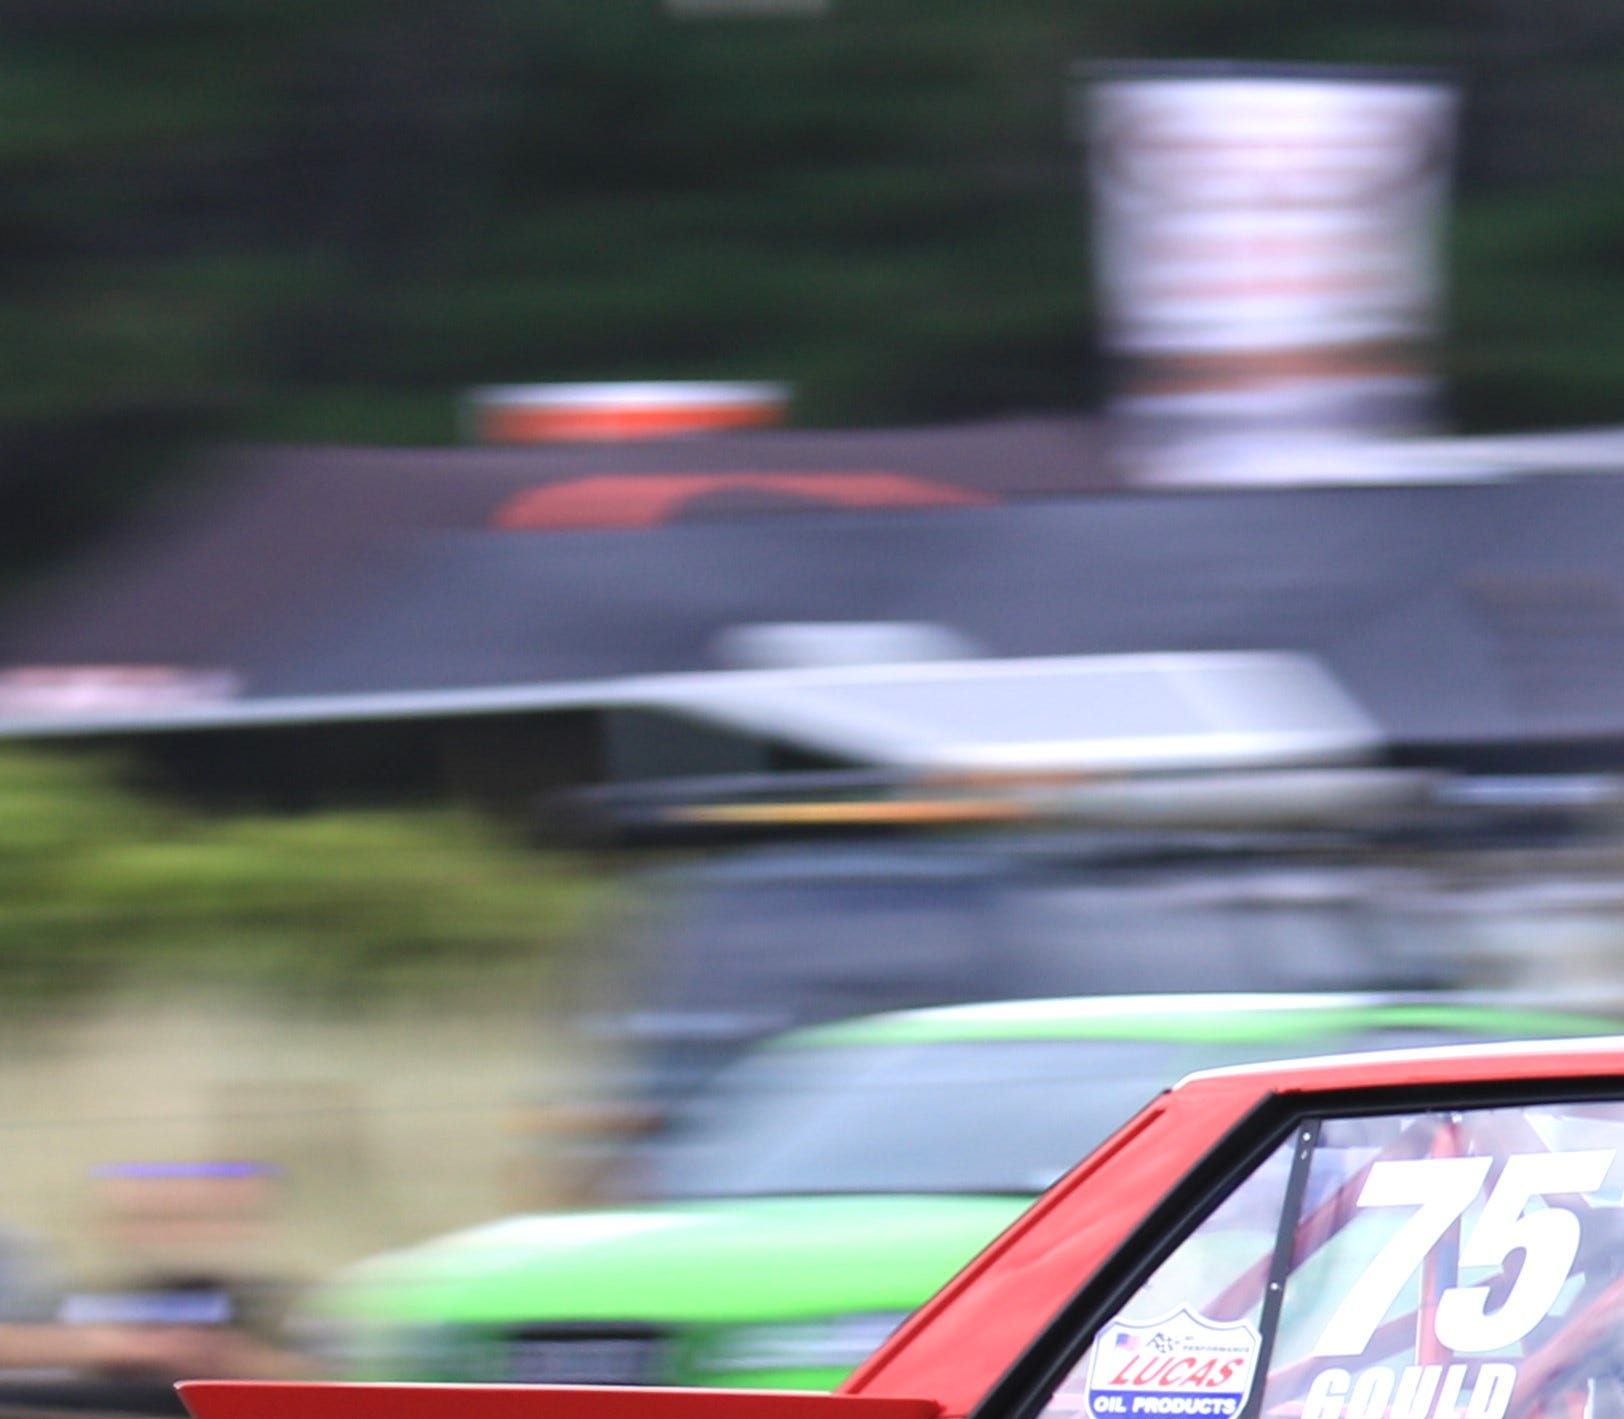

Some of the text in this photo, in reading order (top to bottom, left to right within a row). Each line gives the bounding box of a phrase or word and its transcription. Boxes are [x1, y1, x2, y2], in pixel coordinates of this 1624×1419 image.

[1312, 1149, 1616, 1358] 75
[1108, 1354, 1245, 1388] LUCAS
[1093, 1395, 1237, 1416] OIL PRODUCTS
